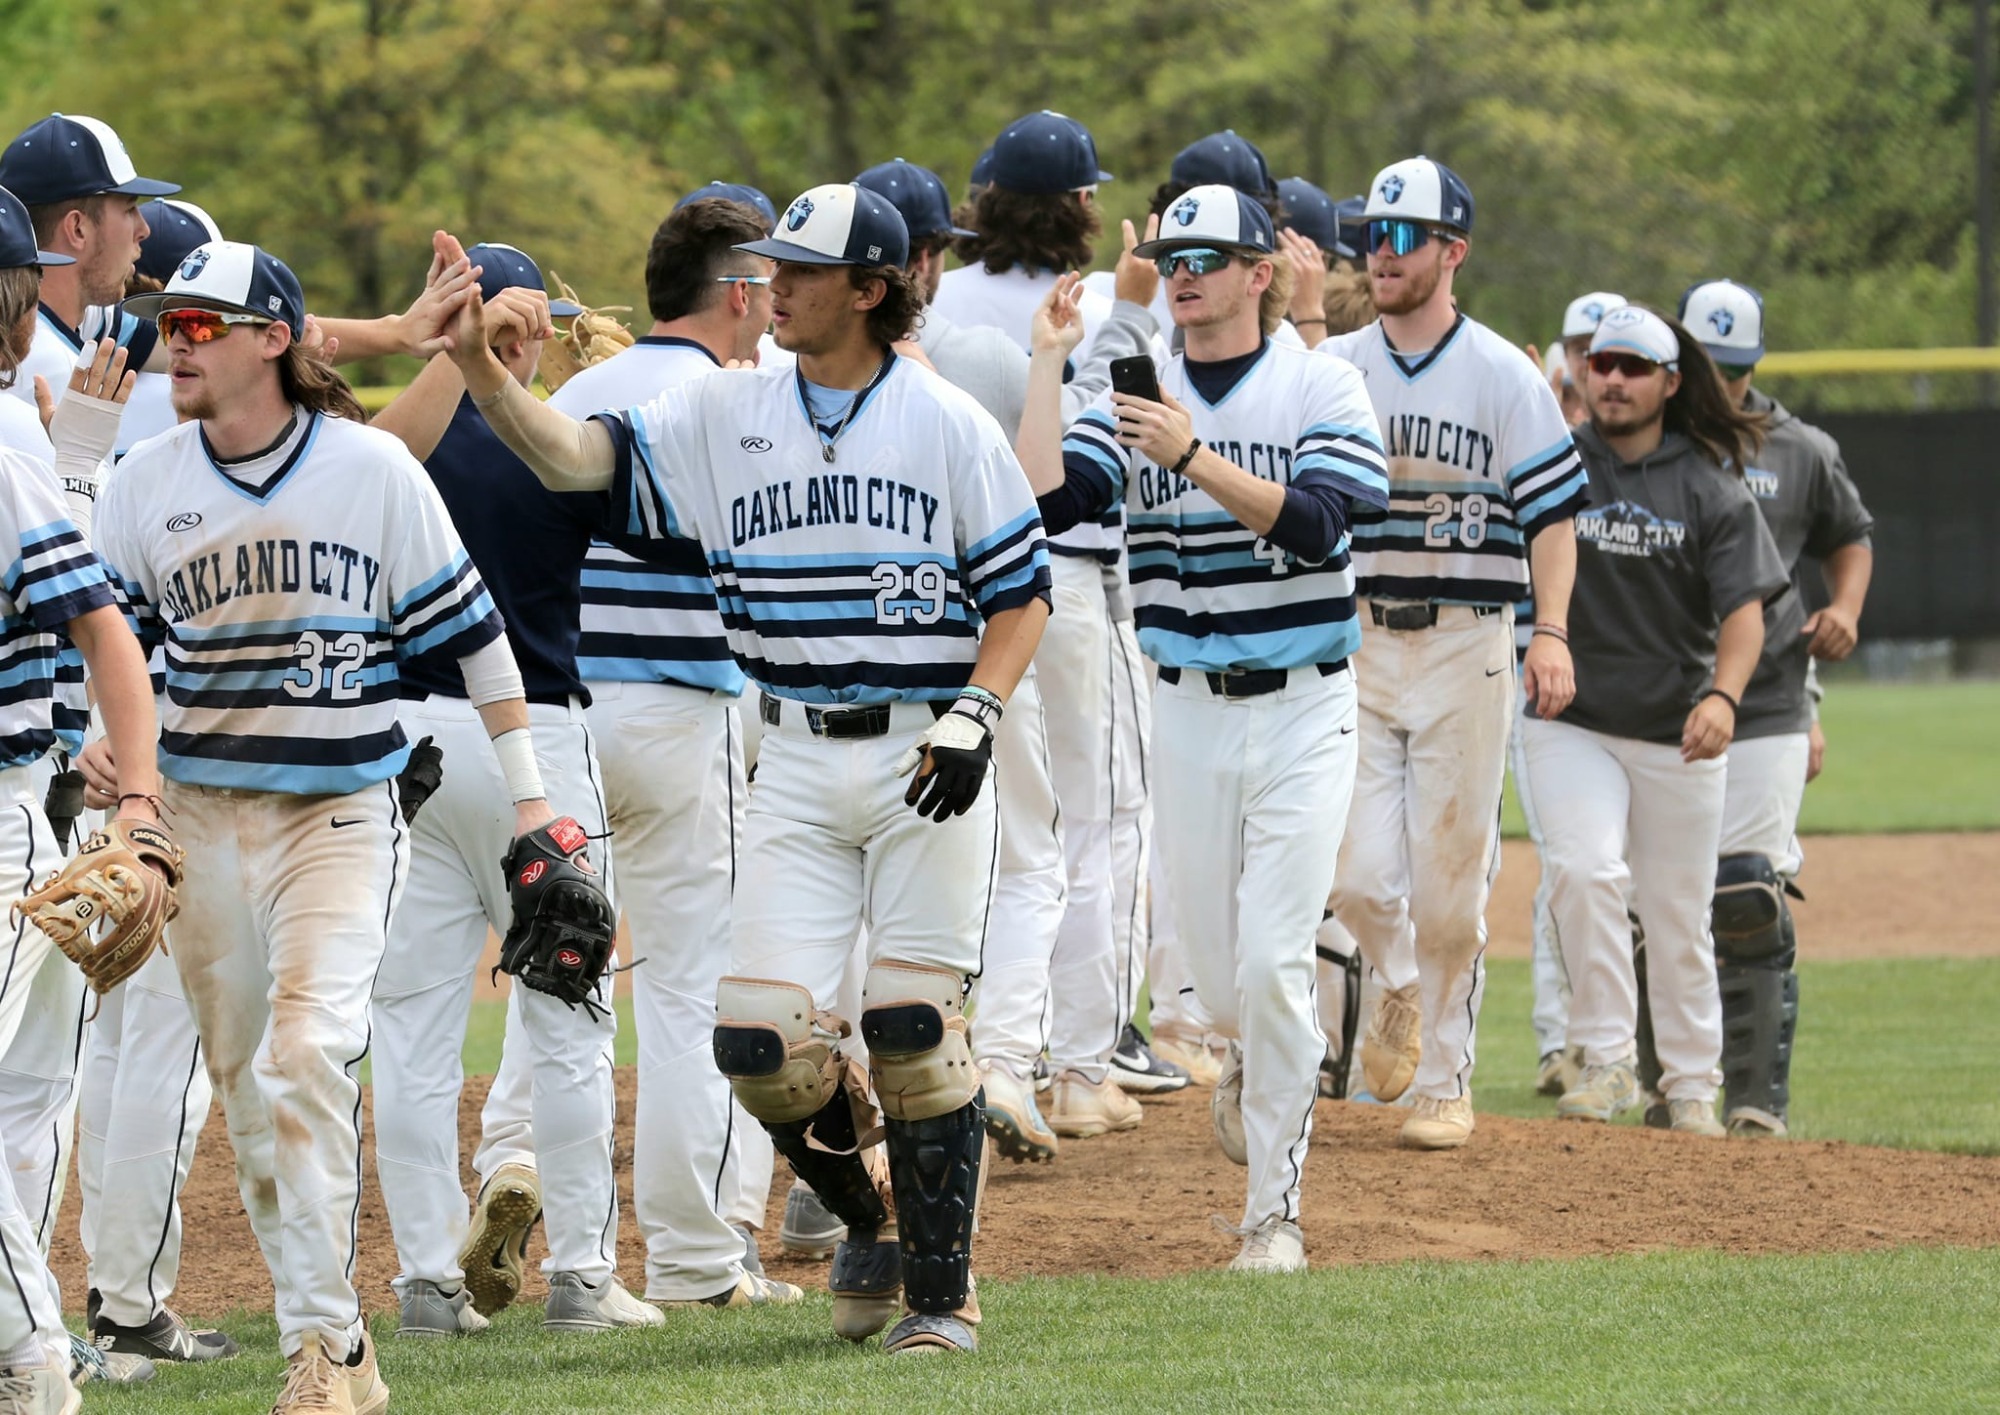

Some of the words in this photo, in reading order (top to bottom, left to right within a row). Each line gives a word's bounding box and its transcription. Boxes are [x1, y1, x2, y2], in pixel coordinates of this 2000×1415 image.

[1250, 442, 1292, 487] CIT
[1437, 421, 1494, 478] CITY
[63, 479, 96, 498] MILY
[732, 475, 858, 547] OAKLAND
[867, 477, 938, 544] CITY
[1424, 493, 1489, 548] 28
[310, 541, 380, 613] CITY
[870, 561, 947, 625] 29
[282, 631, 368, 700] 32
[133, 830, 173, 854] Wilson
[114, 921, 150, 961] A2000
